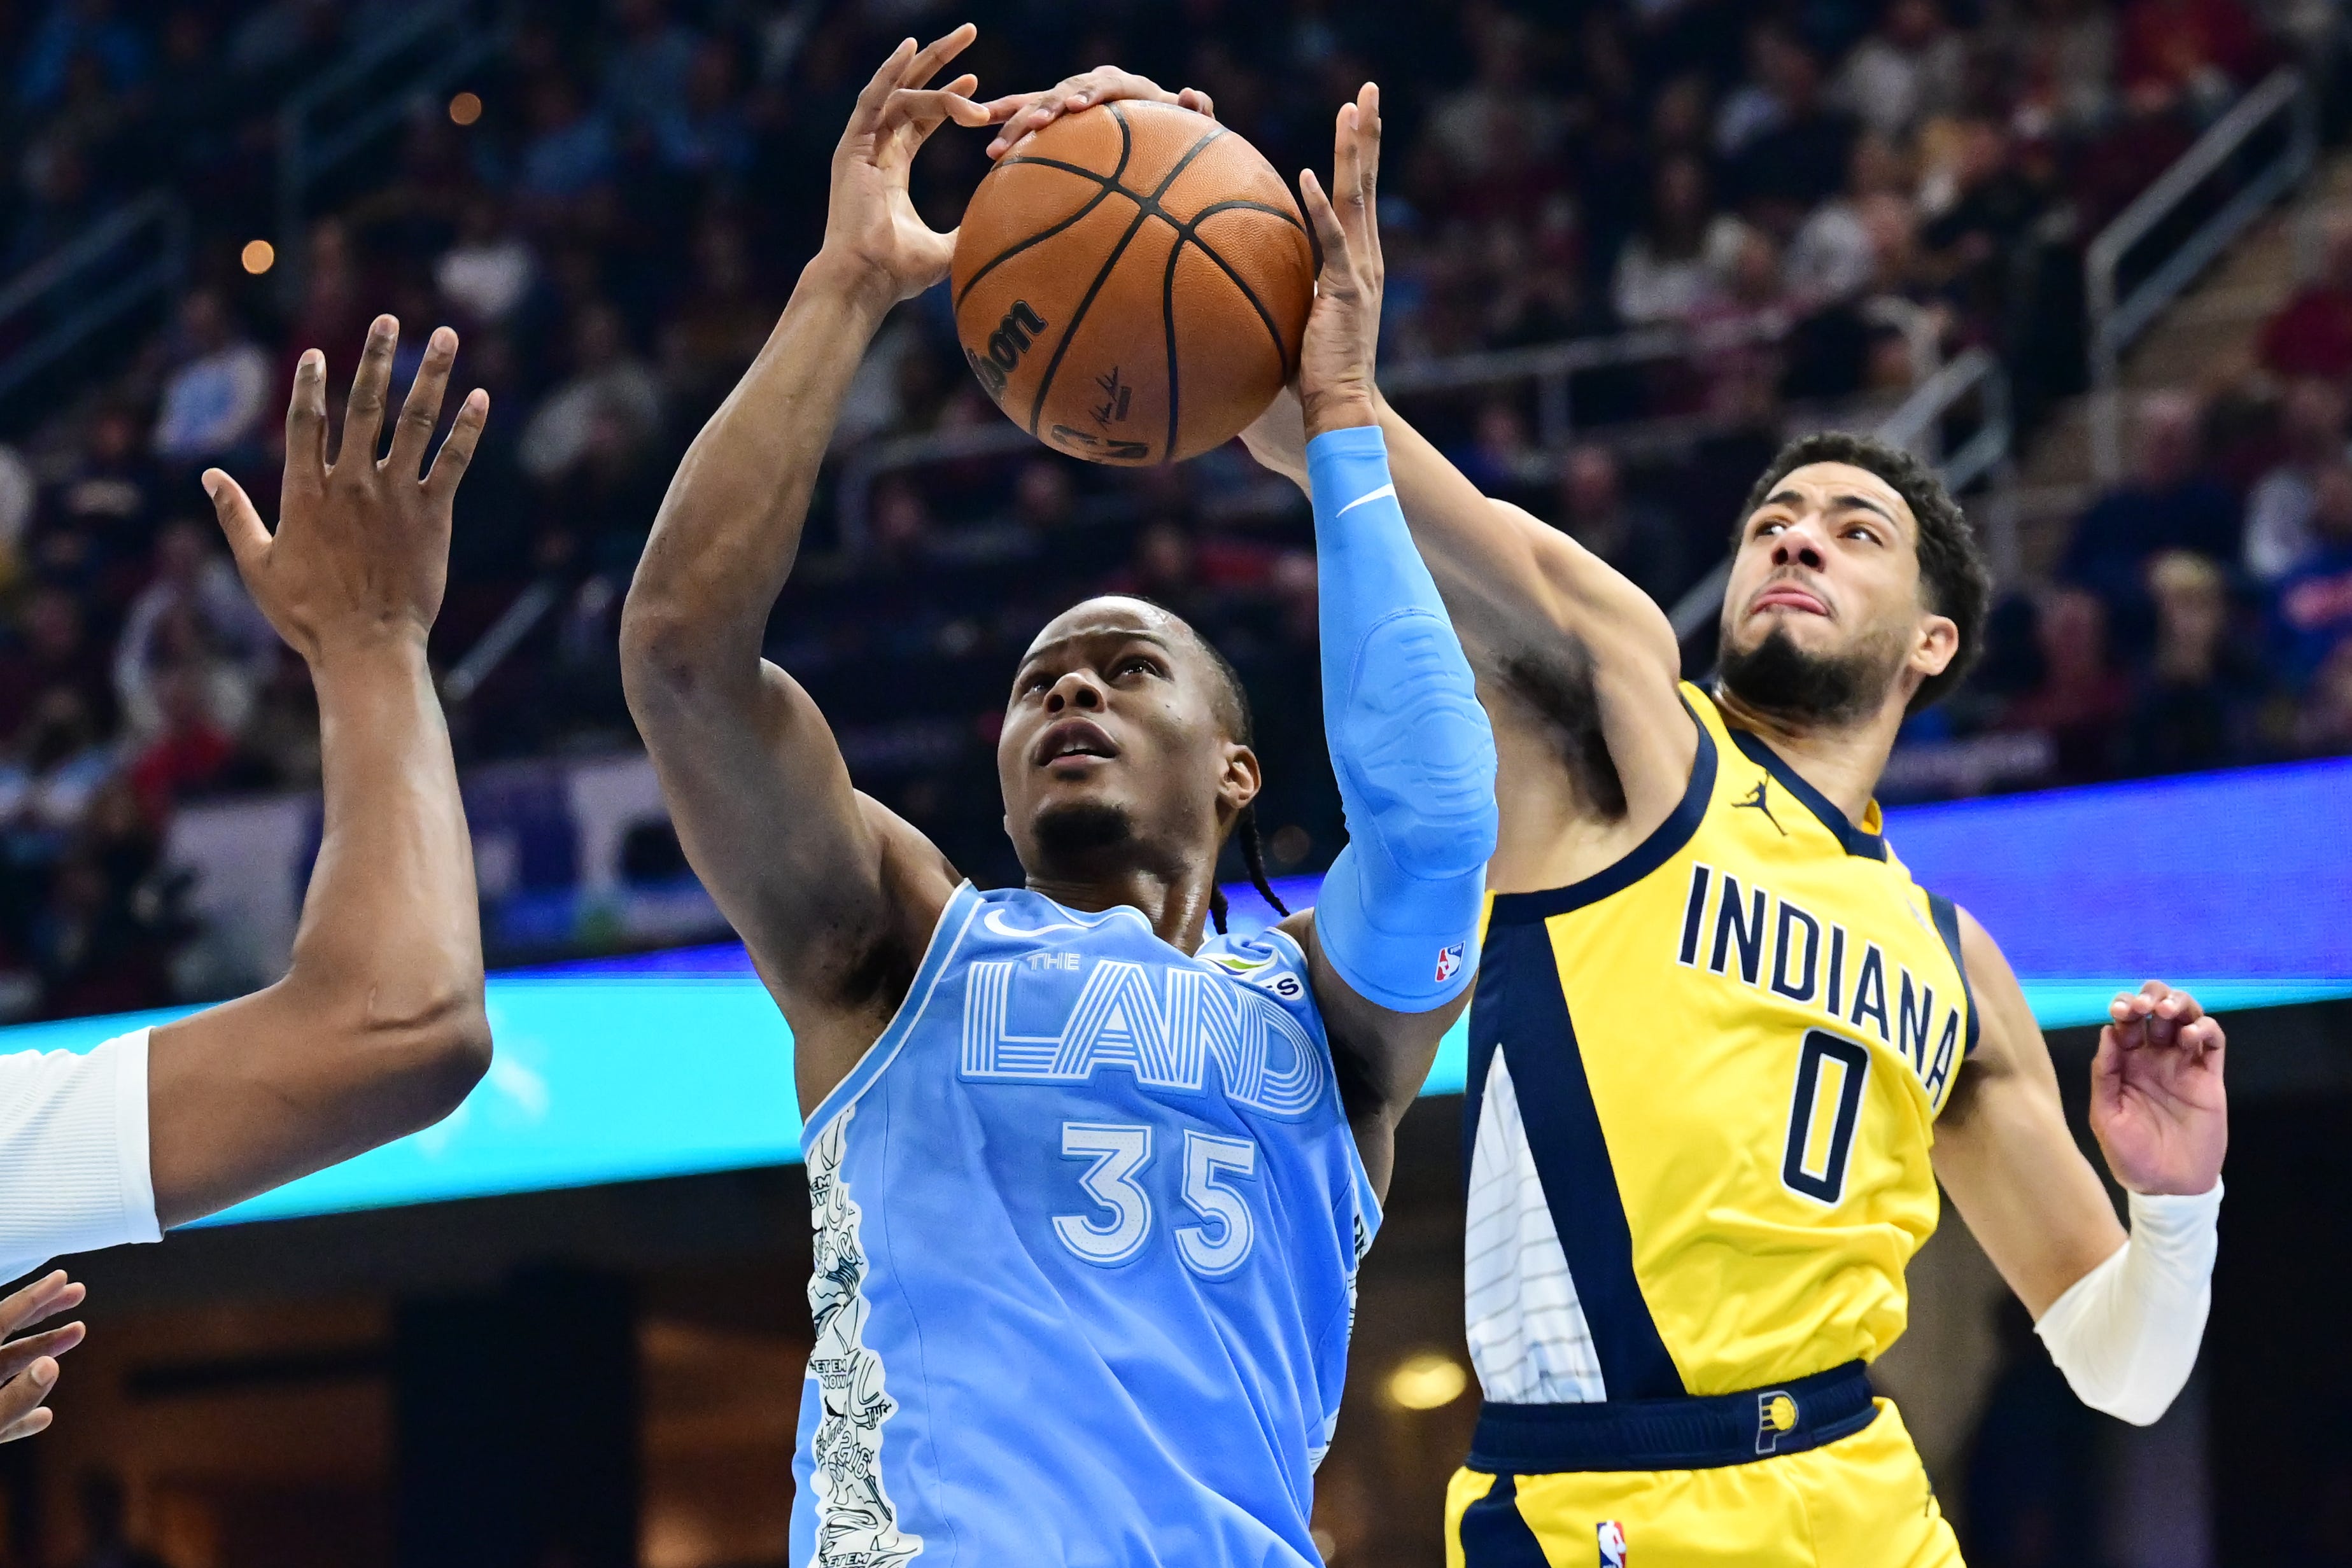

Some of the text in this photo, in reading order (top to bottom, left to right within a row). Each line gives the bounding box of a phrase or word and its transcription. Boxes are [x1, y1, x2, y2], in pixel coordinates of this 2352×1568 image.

[1027, 953, 1080, 970] THE
[1676, 860, 1960, 1114] INDIANA
[961, 959, 1323, 1115] LAND
[1779, 1025, 1870, 1209] 0
[1052, 1122, 1254, 1275] 35
[820, 1375, 847, 1390] NOW
[831, 1359, 847, 1373] EM
[845, 1552, 871, 1565] EM
